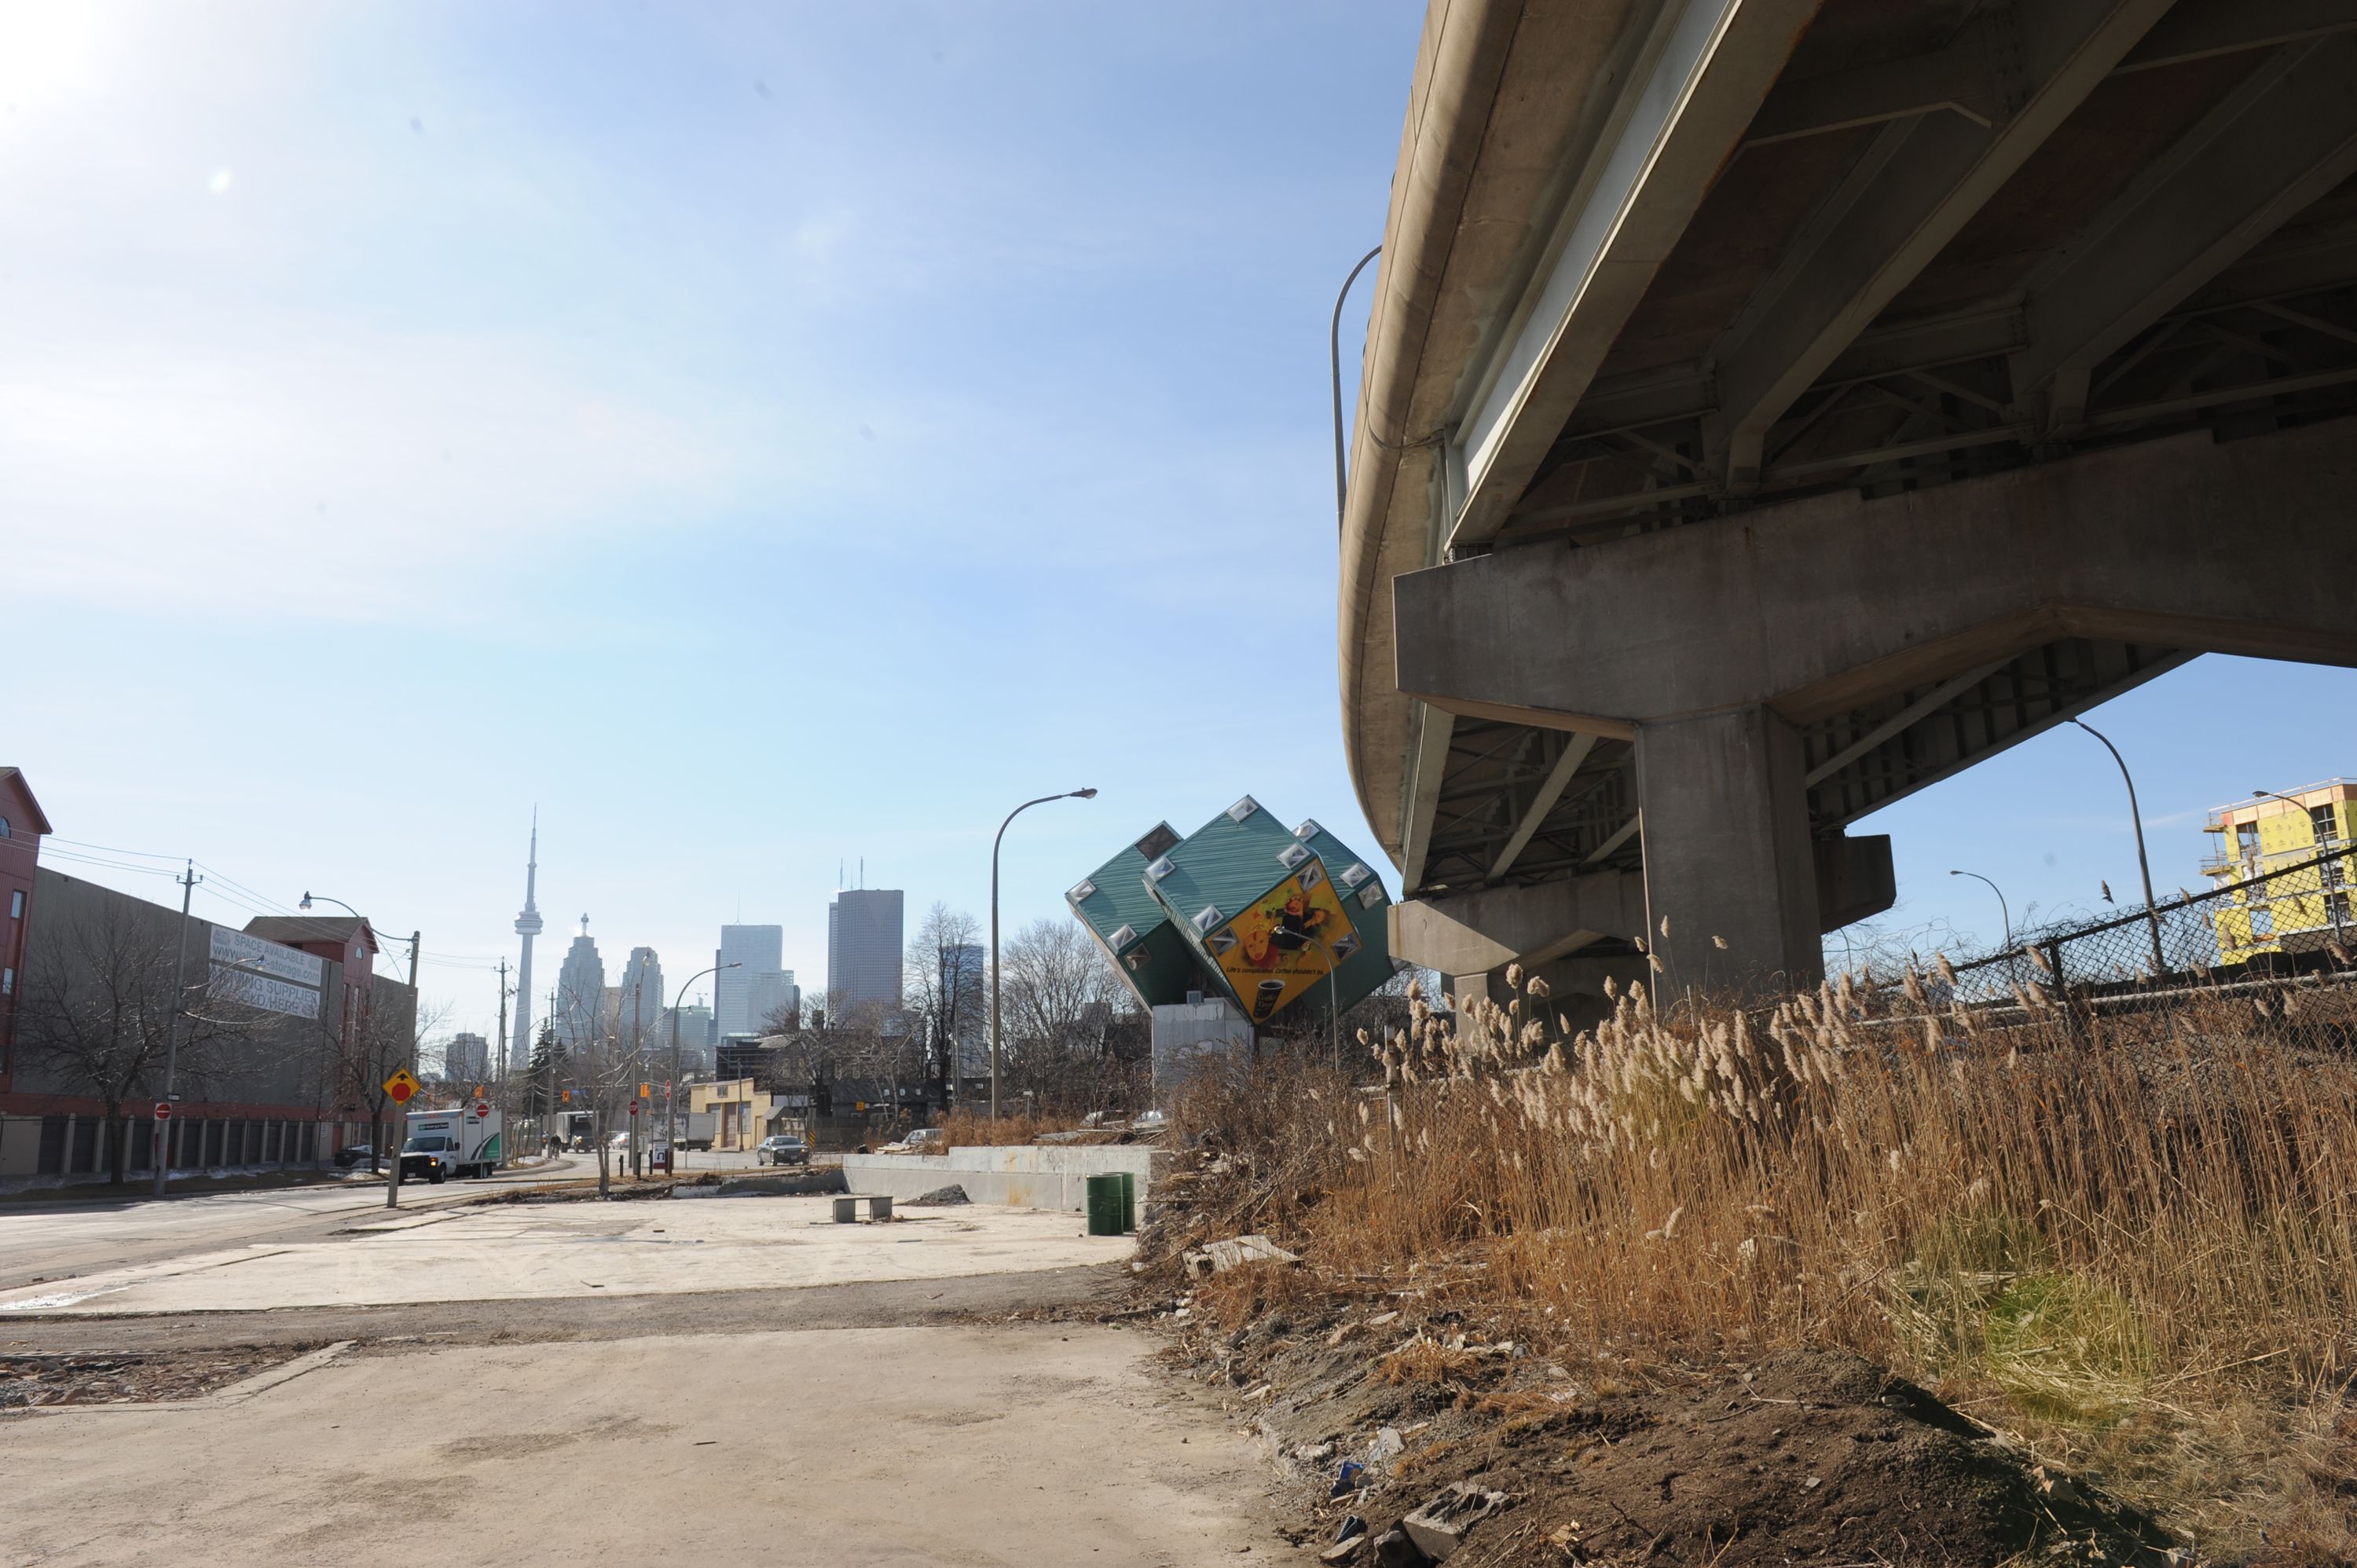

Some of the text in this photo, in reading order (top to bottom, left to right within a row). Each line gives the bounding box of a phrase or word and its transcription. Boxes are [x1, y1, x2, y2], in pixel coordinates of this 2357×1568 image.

[212, 944, 320, 983] www.allc-storage.com
[234, 935, 262, 952] SPACE
[264, 945, 305, 965] AVAILABLE
[267, 980, 317, 1004] SUPPLIES
[269, 996, 299, 1013] HERE
